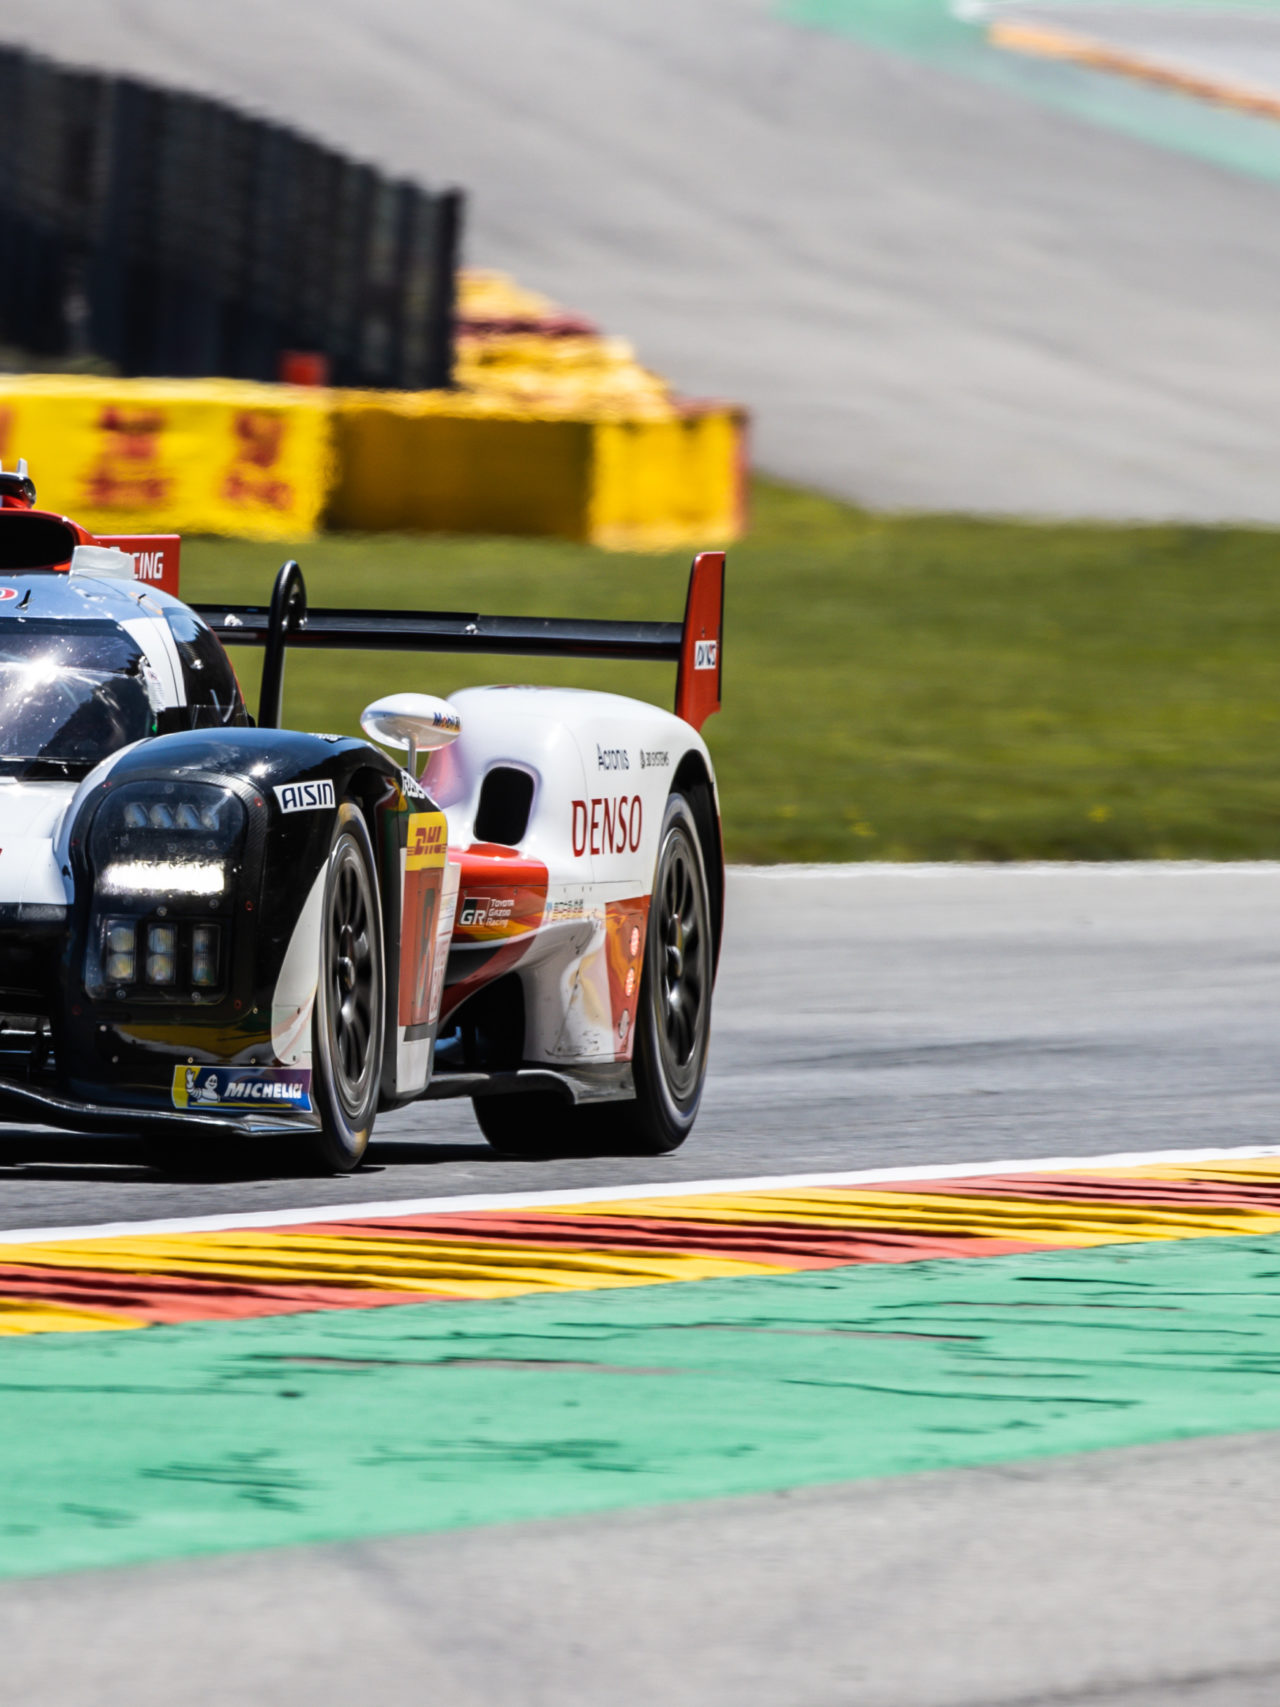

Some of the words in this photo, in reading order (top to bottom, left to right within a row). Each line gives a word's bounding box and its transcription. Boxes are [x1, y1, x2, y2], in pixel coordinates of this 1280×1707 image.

[132, 551, 164, 579] CING
[597, 743, 630, 771] Acronis
[281, 783, 333, 809] AISIN
[571, 795, 642, 858] DENSO
[460, 910, 486, 925] GR
[224, 1082, 303, 1099] MICHELIN
